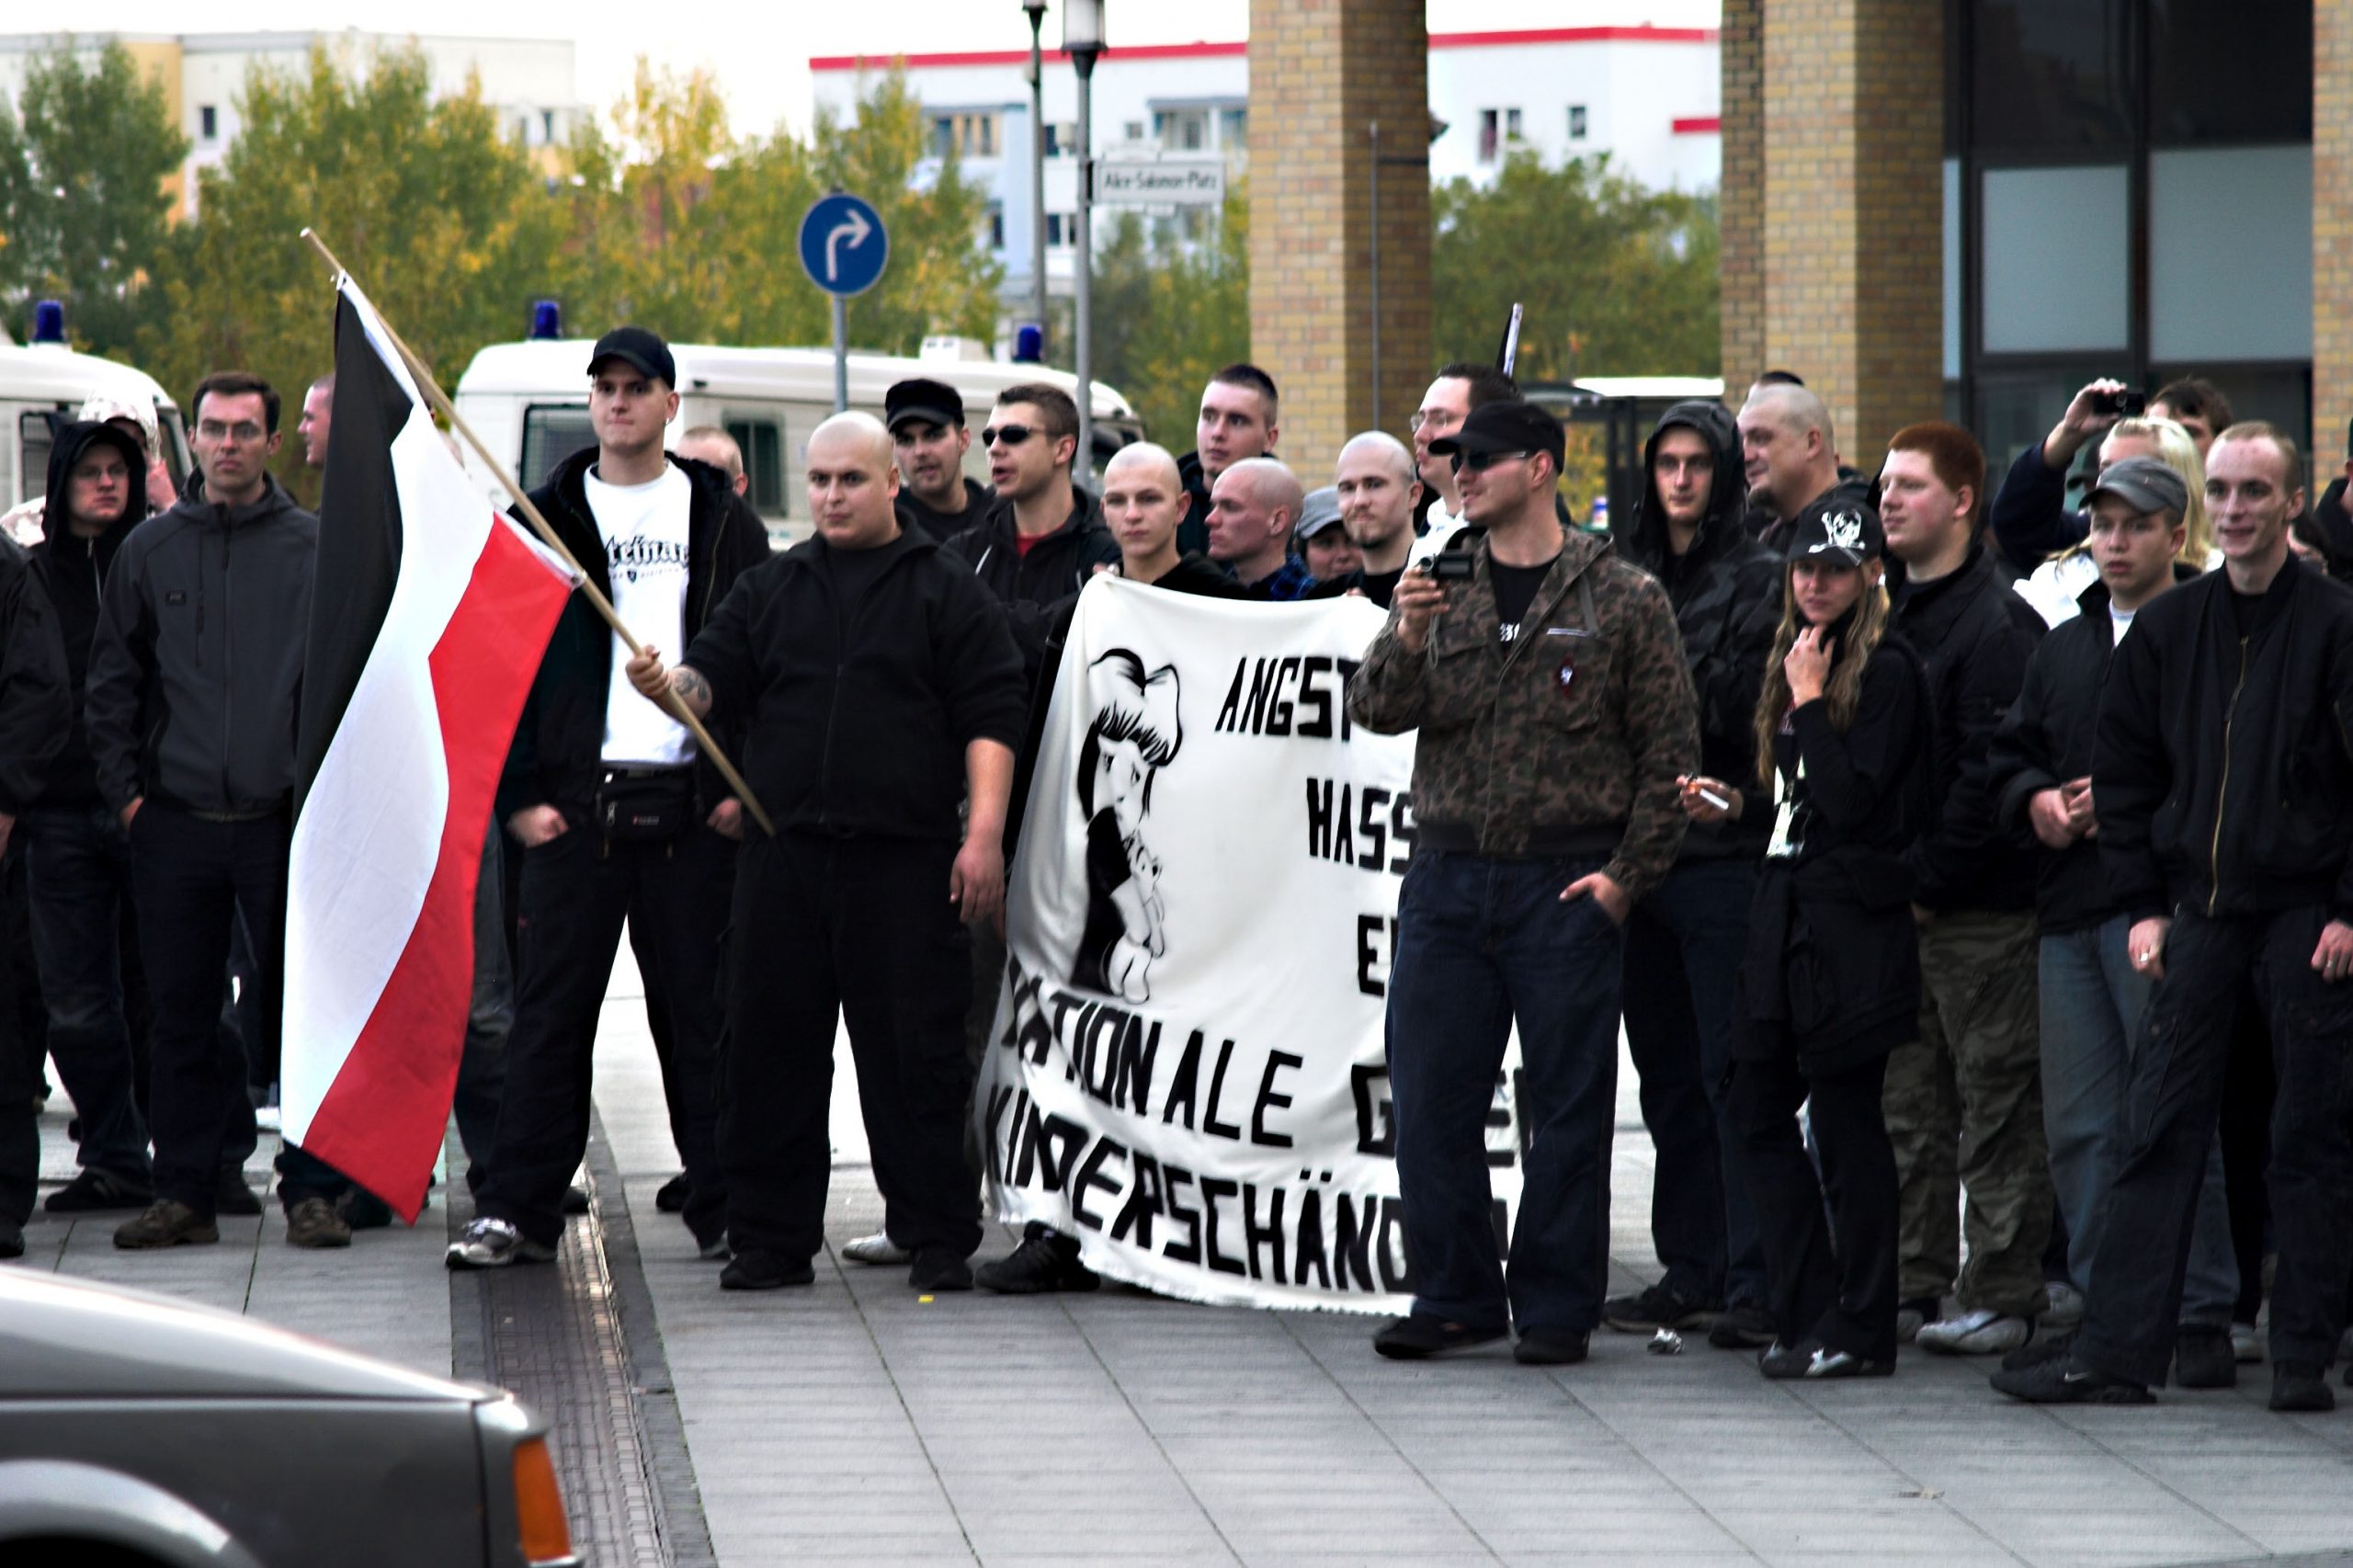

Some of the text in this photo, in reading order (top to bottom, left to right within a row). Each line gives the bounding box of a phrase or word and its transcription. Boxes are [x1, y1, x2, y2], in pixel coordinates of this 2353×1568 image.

[1307, 778, 1417, 876] HASS
[1358, 914, 1398, 997] E
[985, 1085, 1507, 1292] KINDERSCHÄND
